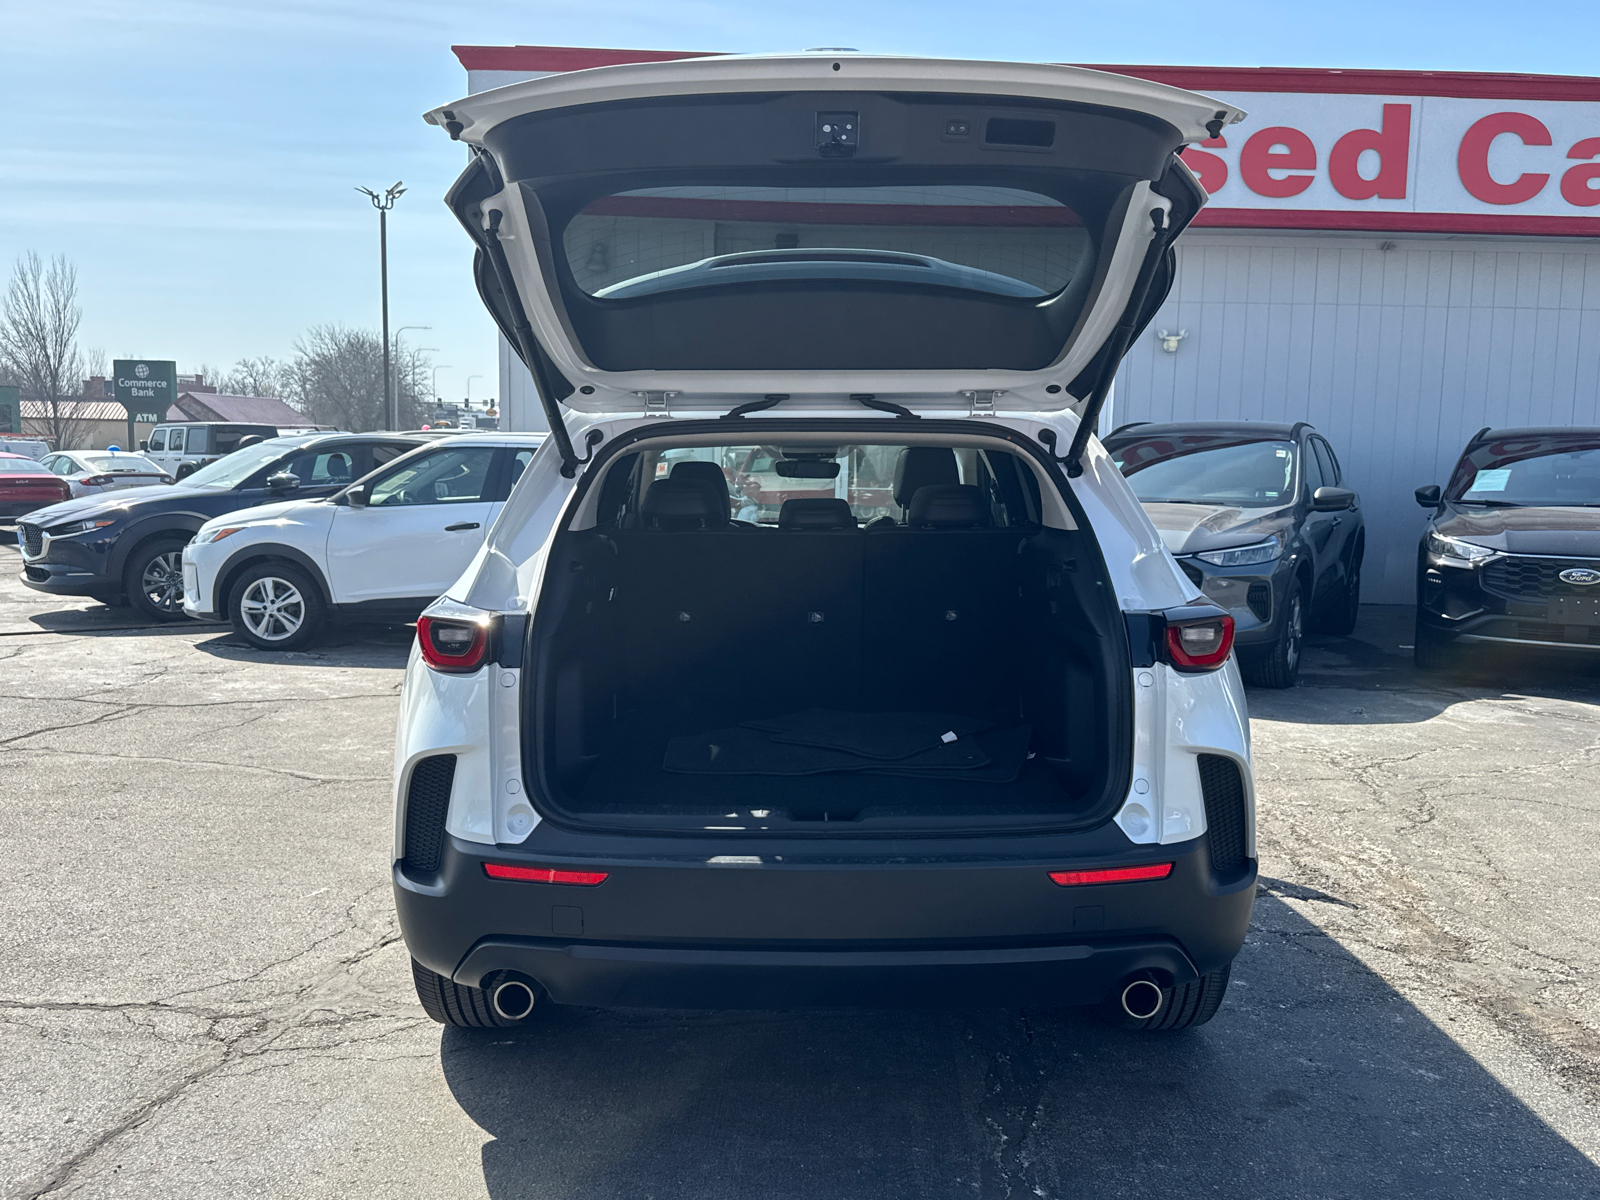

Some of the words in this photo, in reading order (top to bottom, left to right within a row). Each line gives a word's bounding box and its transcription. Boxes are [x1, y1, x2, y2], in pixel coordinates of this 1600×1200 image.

[1180, 103, 1412, 200] sed
[118, 378, 167, 388] Commerce
[131, 388, 155, 397] Bank
[135, 413, 158, 422] ATM
[1569, 571, 1594, 582] Ford
